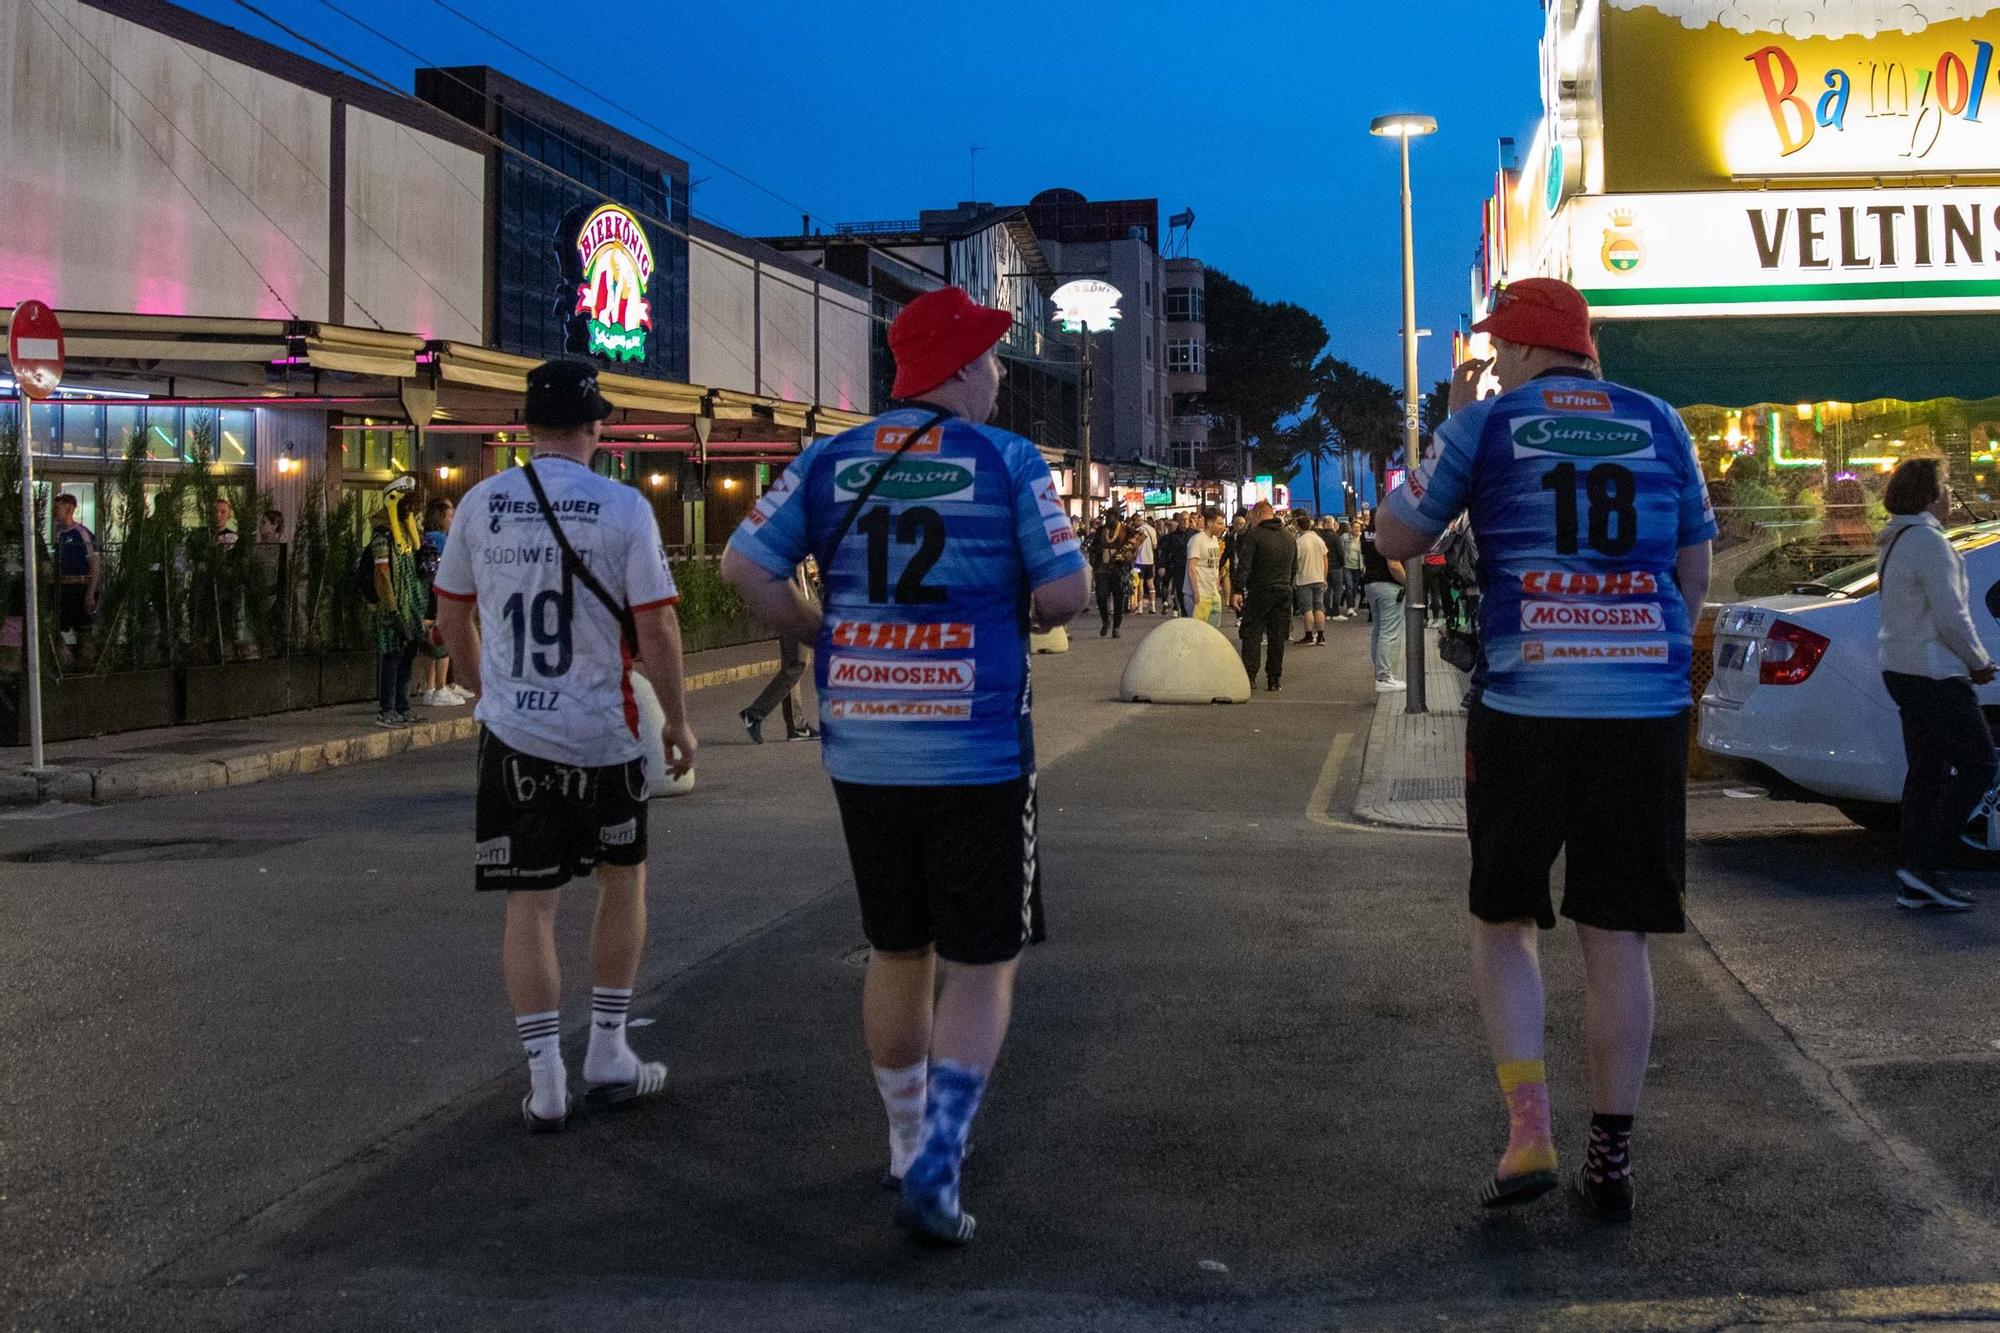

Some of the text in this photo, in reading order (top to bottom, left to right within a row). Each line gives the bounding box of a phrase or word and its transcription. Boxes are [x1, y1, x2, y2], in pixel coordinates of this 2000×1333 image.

[581, 215, 650, 277] BIERKÖNIG
[1746, 204, 2000, 269] VELTIN
[1551, 395, 1604, 406] STIHL
[882, 432, 933, 446] STL
[1526, 419, 1640, 445] Samson
[1541, 461, 1637, 556] 18
[857, 504, 949, 606] 12
[1521, 570, 1657, 595] CLAAS
[1529, 606, 1657, 627] MONOSEM
[502, 590, 574, 678] 19
[831, 621, 974, 651] CLAAS
[1551, 645, 1668, 659] AMAZONE
[833, 663, 965, 686] MONOSEM
[515, 690, 560, 711] VELZ
[849, 702, 970, 717] AMAZONE
